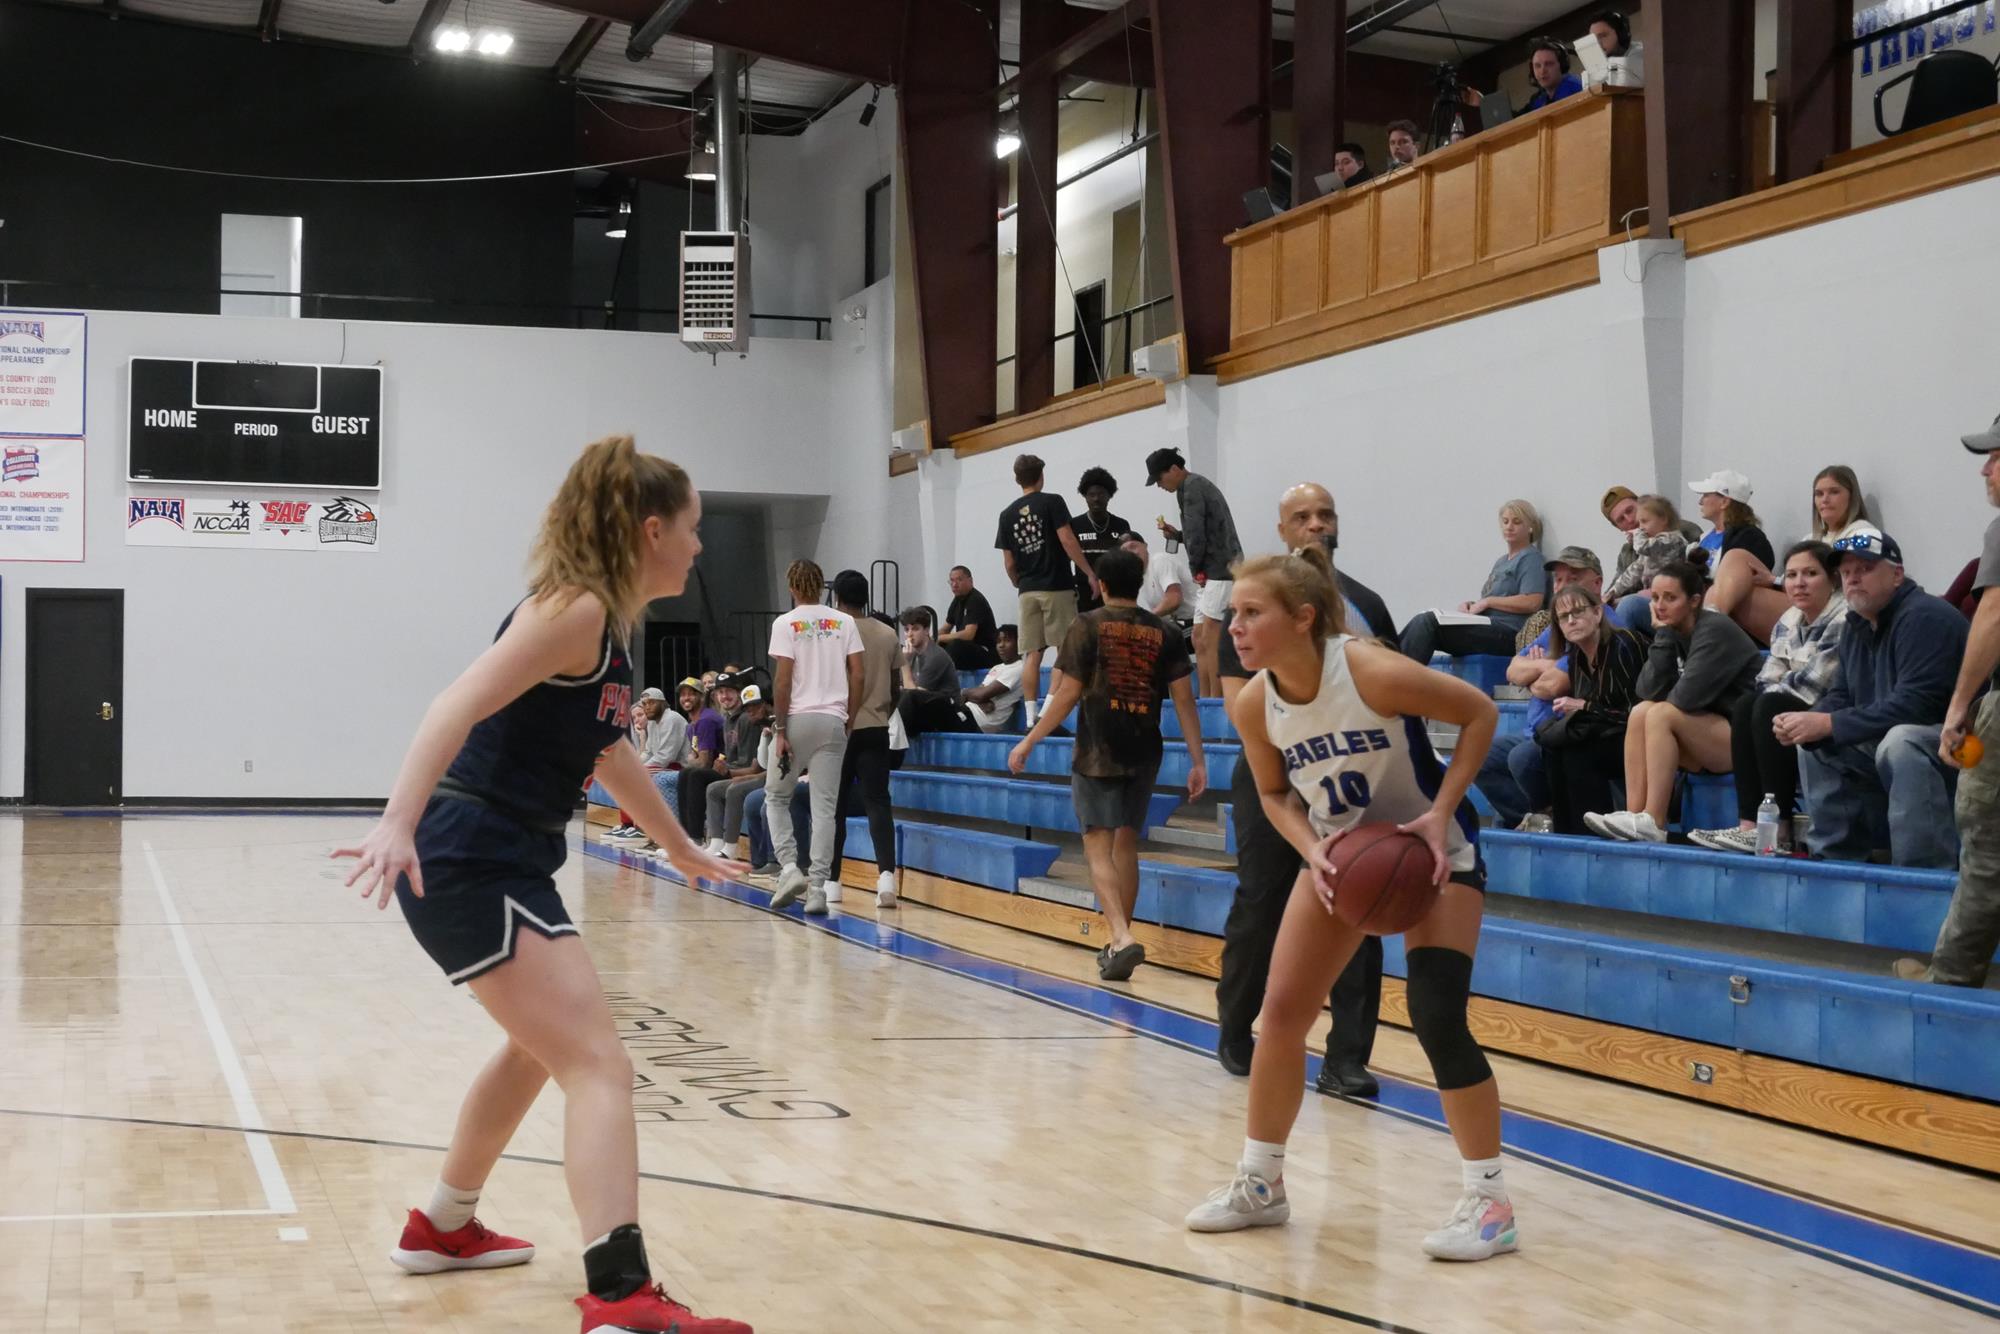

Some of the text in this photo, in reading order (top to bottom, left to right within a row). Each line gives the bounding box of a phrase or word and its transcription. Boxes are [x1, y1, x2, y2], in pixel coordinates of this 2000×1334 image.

[145, 409, 197, 428] HOME
[312, 415, 370, 435] GUEST
[234, 423, 278, 436] PERIOD
[130, 500, 182, 525] NAIA
[264, 502, 309, 524] SAC
[194, 516, 250, 531] NCCAA
[1079, 532, 1097, 541] TRUE
[1285, 728, 1391, 772] EAGLES
[1319, 770, 1372, 816] 10
